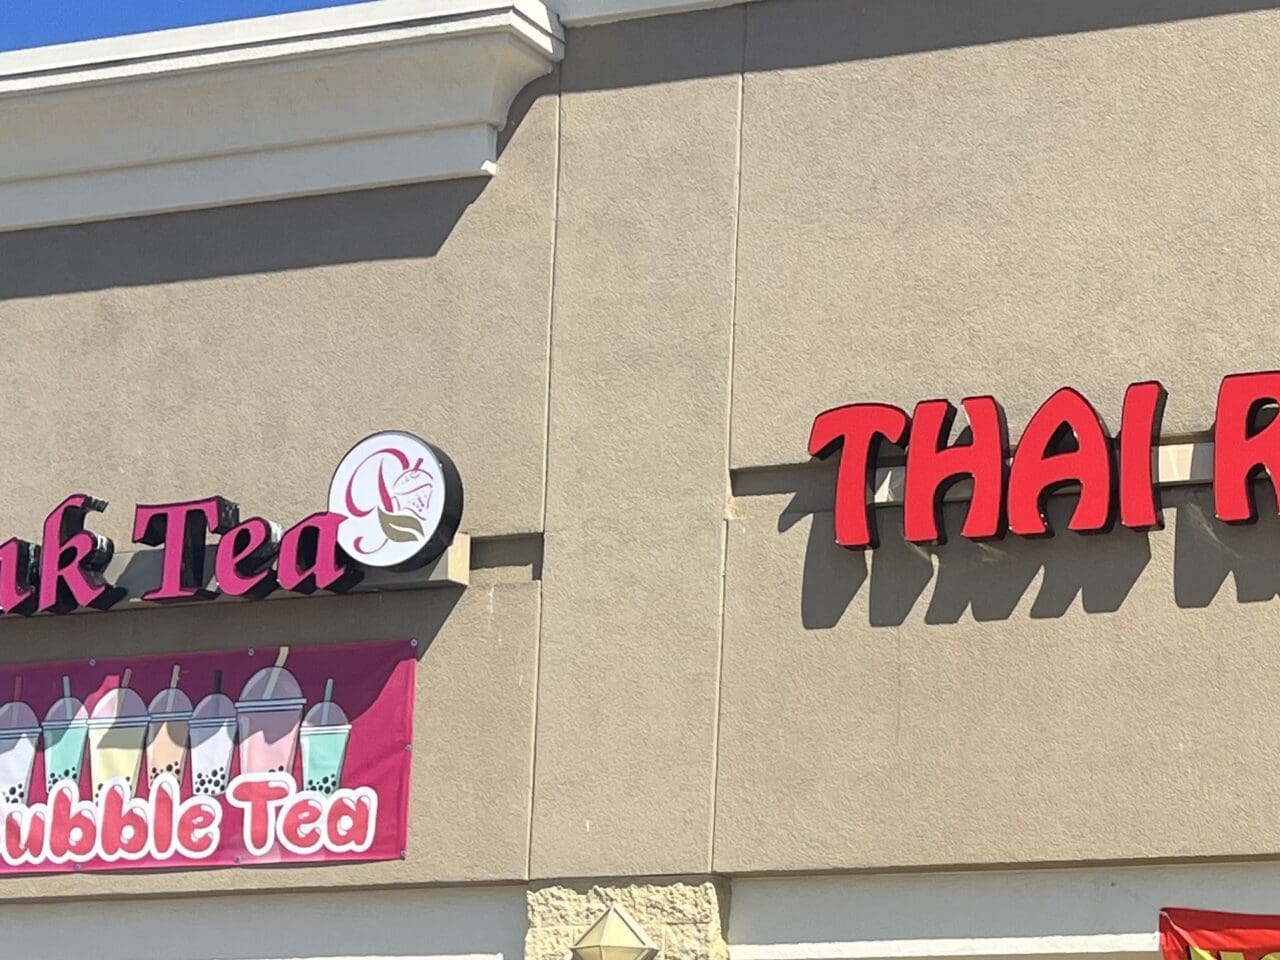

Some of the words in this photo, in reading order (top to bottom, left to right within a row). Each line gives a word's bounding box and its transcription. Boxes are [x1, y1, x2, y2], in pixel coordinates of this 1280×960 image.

[807, 379, 1165, 548] THAI
[133, 496, 348, 599] Tea
[227, 772, 378, 858] Tea
